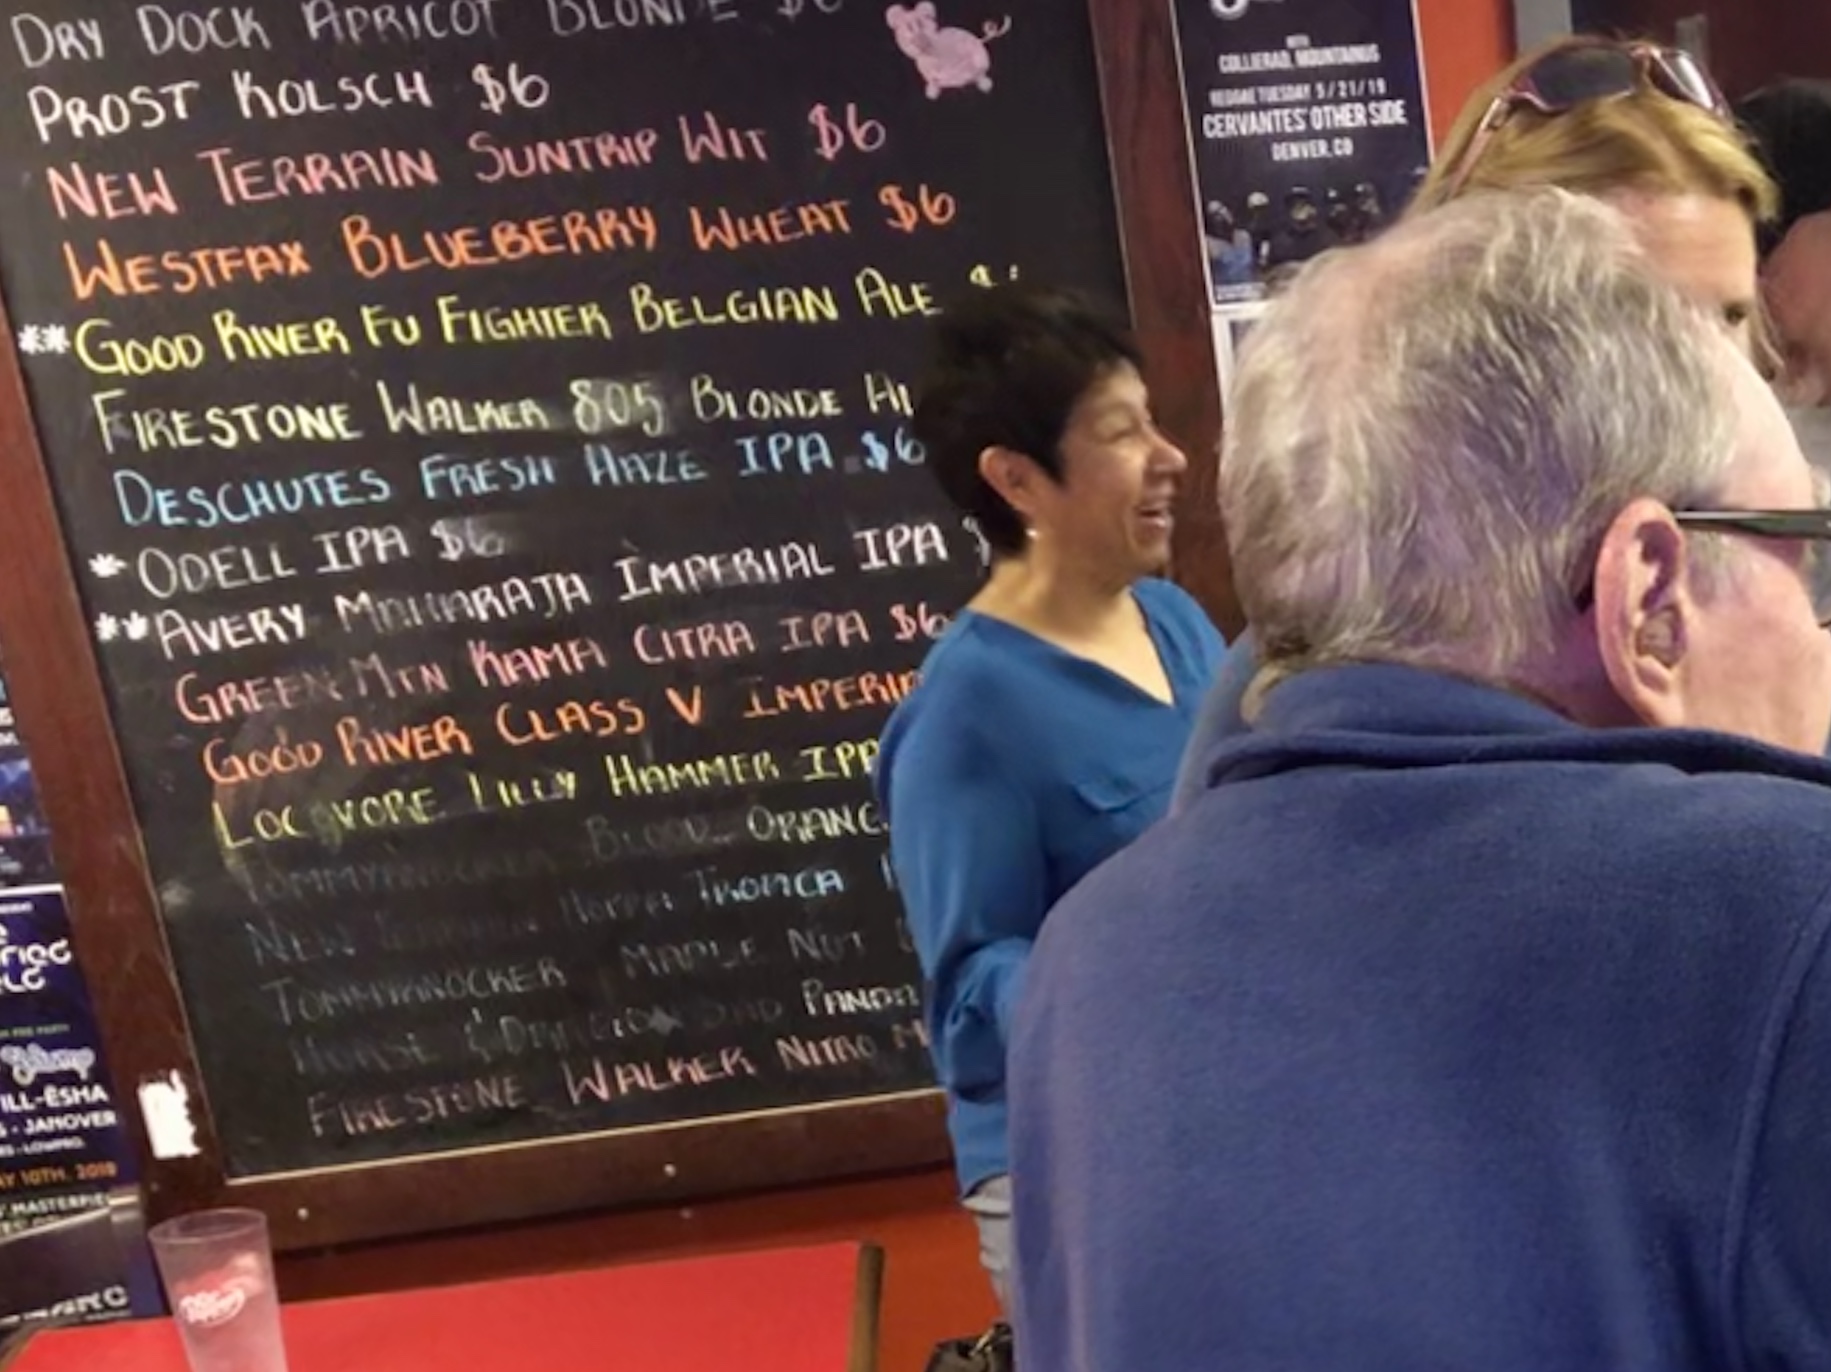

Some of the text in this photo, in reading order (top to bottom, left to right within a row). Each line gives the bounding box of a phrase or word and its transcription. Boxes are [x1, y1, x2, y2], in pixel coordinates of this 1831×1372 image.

[10, 13, 104, 69] DRY
[139, 4, 271, 54] DOCK
[302, 0, 502, 45] APRICOT
[28, 62, 551, 143] PROST KOLSCH $6
[1309, 101, 1368, 131] OTHER
[1368, 99, 1408, 126] SIDE
[46, 103, 887, 220] NEW TERRAIN SUNTRIP WIT $6
[62, 183, 957, 300] WESTFAX BLUEBERRY WHEAT $6
[73, 317, 204, 377] GOOD
[213, 309, 351, 361] RIVER
[361, 305, 421, 348] FU
[436, 294, 613, 343] FIGHTER
[629, 281, 838, 334] BELGIAN
[854, 265, 943, 317] ALE
[92, 387, 363, 455] FIRESTONE
[374, 379, 550, 436] WALKER
[568, 376, 666, 436] 805
[112, 426, 926, 529] DESCHUTES FRESH HAZE IPA $6
[136, 542, 296, 600] ODELL
[312, 524, 411, 576] IPA
[155, 603, 306, 661] AVERY
[614, 547, 836, 602] IMPERIAL
[852, 521, 950, 572] IPA
[174, 670, 341, 724] GREEN
[467, 638, 608, 689] KAMA
[633, 619, 757, 667] CITRA
[780, 612, 870, 655] IPA
[889, 602, 948, 642] $6
[202, 728, 323, 787] GOOD
[336, 713, 474, 767] RIVER
[496, 697, 648, 749] CLASS
[666, 687, 704, 724] V
[605, 749, 781, 797] HAMMER
[562, 1044, 756, 1105] WALKER
